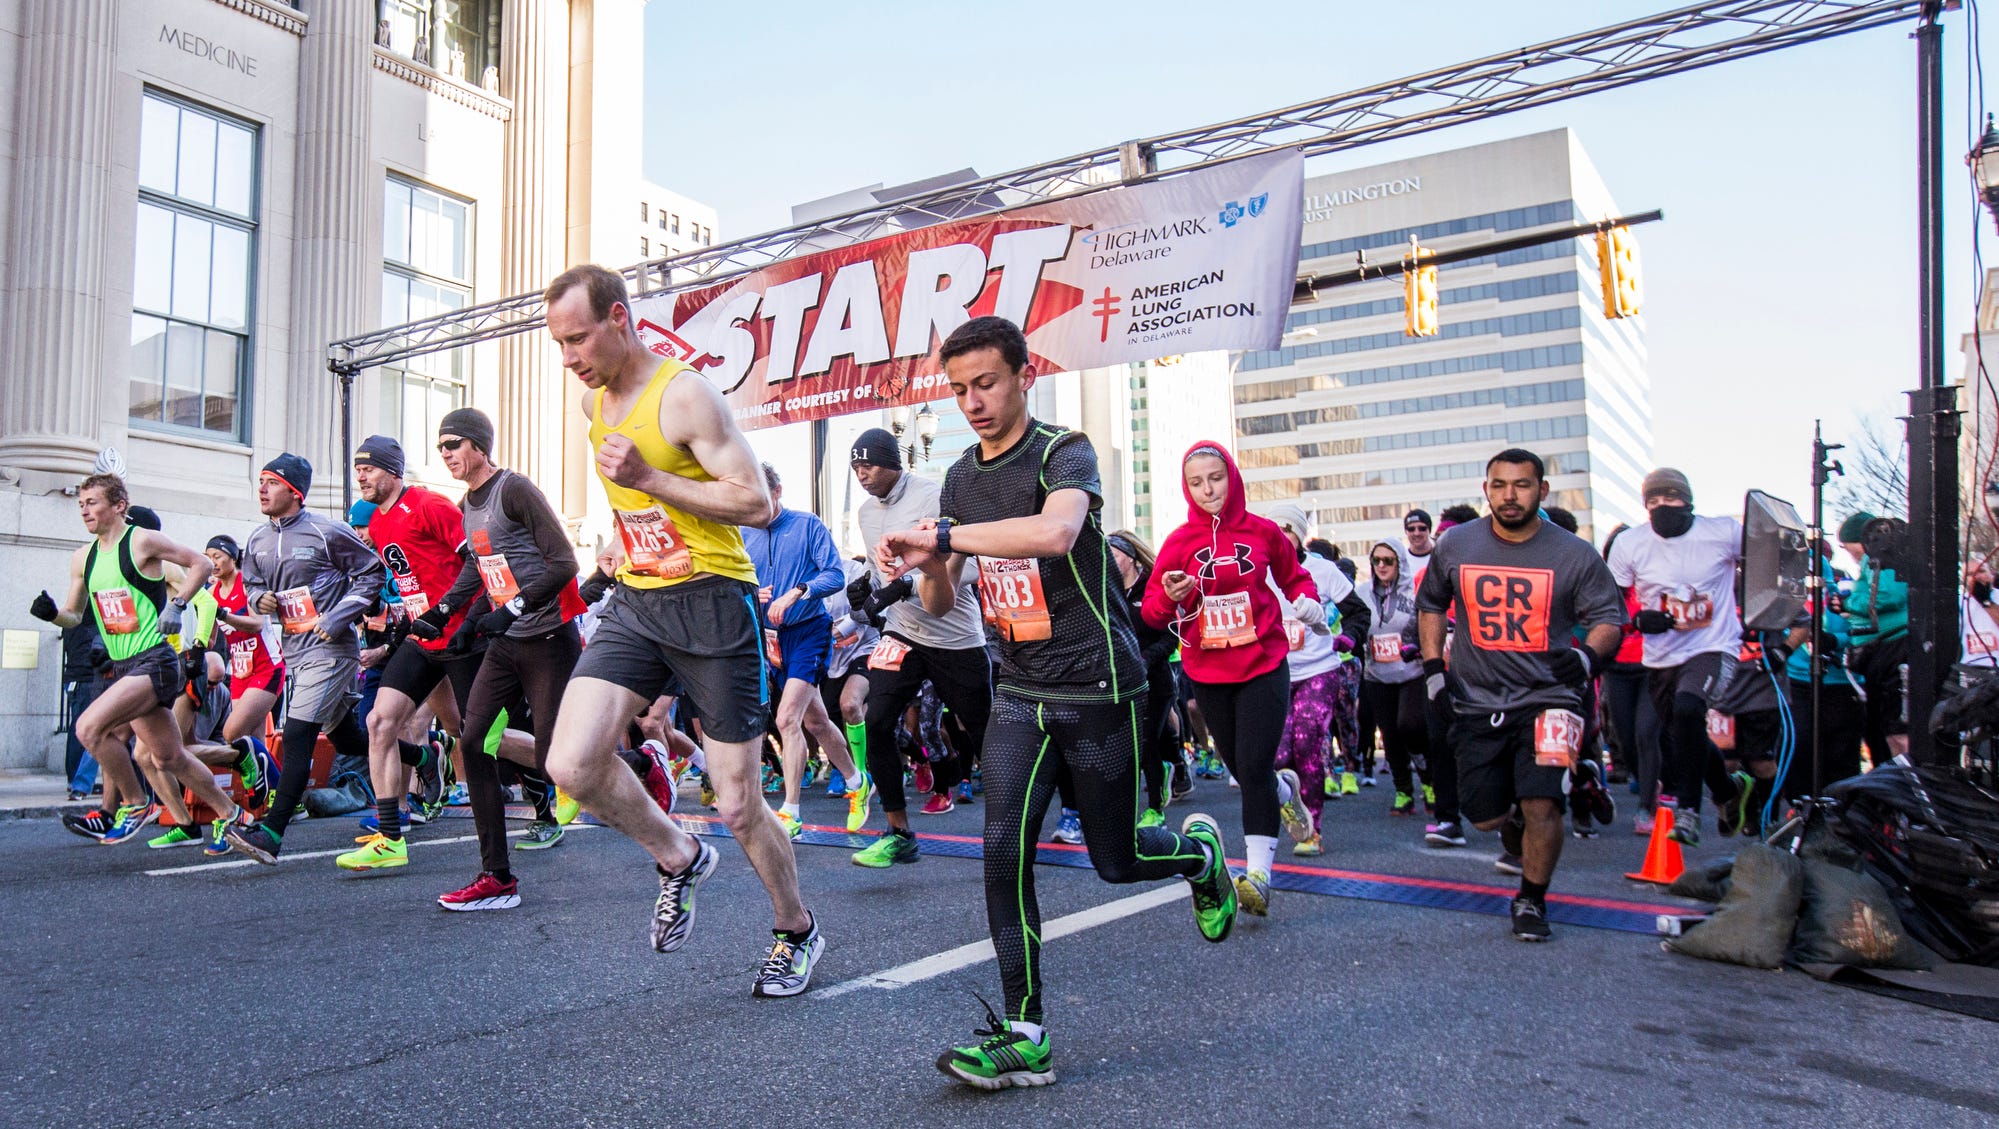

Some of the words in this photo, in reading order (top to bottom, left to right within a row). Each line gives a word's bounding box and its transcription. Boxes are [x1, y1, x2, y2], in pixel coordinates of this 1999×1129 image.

[159, 24, 257, 77] MEDICINE
[1304, 176, 1421, 211] ILMINGTON
[1093, 216, 1207, 253] HIGHMARK
[1090, 245, 1172, 270] Delaware
[1130, 269, 1224, 301] AMERICAN
[700, 223, 1076, 395] START
[1127, 302, 1255, 335] ASSOCIATION
[1131, 297, 1183, 318] LUNG
[1127, 337, 1138, 345] IN
[1142, 326, 1193, 344] DELAWARE
[733, 401, 782, 420] BANNER
[785, 388, 851, 411] COURTESY
[853, 384, 872, 399] OF
[625, 522, 675, 553] 1265
[984, 574, 1034, 609] 1283
[1475, 574, 1533, 611] CR
[281, 599, 307, 618] 775
[1204, 605, 1247, 631] 1115
[1478, 611, 1531, 643] 5K
